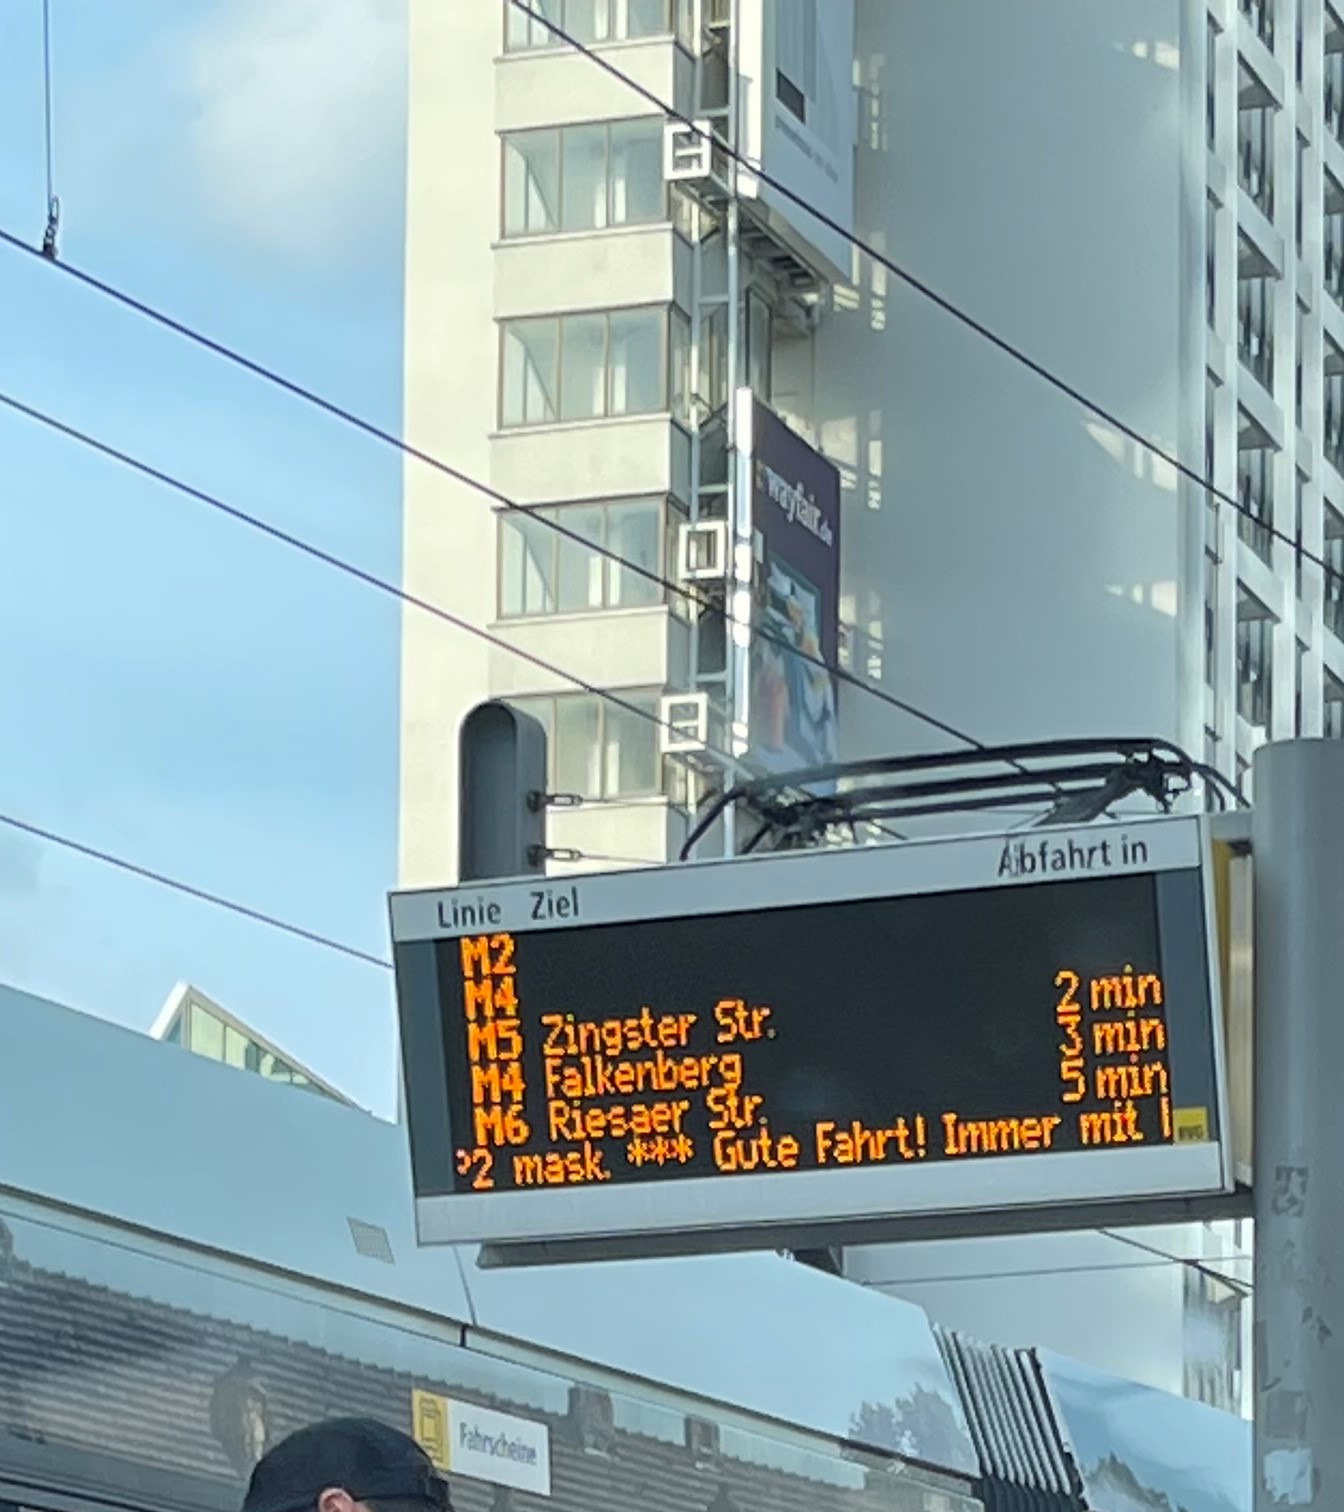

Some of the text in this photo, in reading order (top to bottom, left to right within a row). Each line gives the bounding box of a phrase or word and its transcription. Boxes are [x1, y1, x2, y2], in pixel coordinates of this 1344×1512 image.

[998, 834, 1148, 878] Abfahrt in
[437, 888, 579, 929] Linie Ziel
[460, 931, 517, 977] M2
[464, 976, 518, 1020] M4
[468, 964, 1163, 1061] M5 Zingster Str. 2 min
[471, 1010, 1166, 1104] M4 Falkenberg 3 min
[474, 1054, 1170, 1147] M6 Riesaer Str. 5 min
[713, 1126, 800, 1172] Gute
[816, 1113, 927, 1163] Fahrt!
[941, 1111, 1061, 1155] Immer
[1079, 1099, 1144, 1144] mit
[459, 1422, 538, 1466] Fahrscheine
